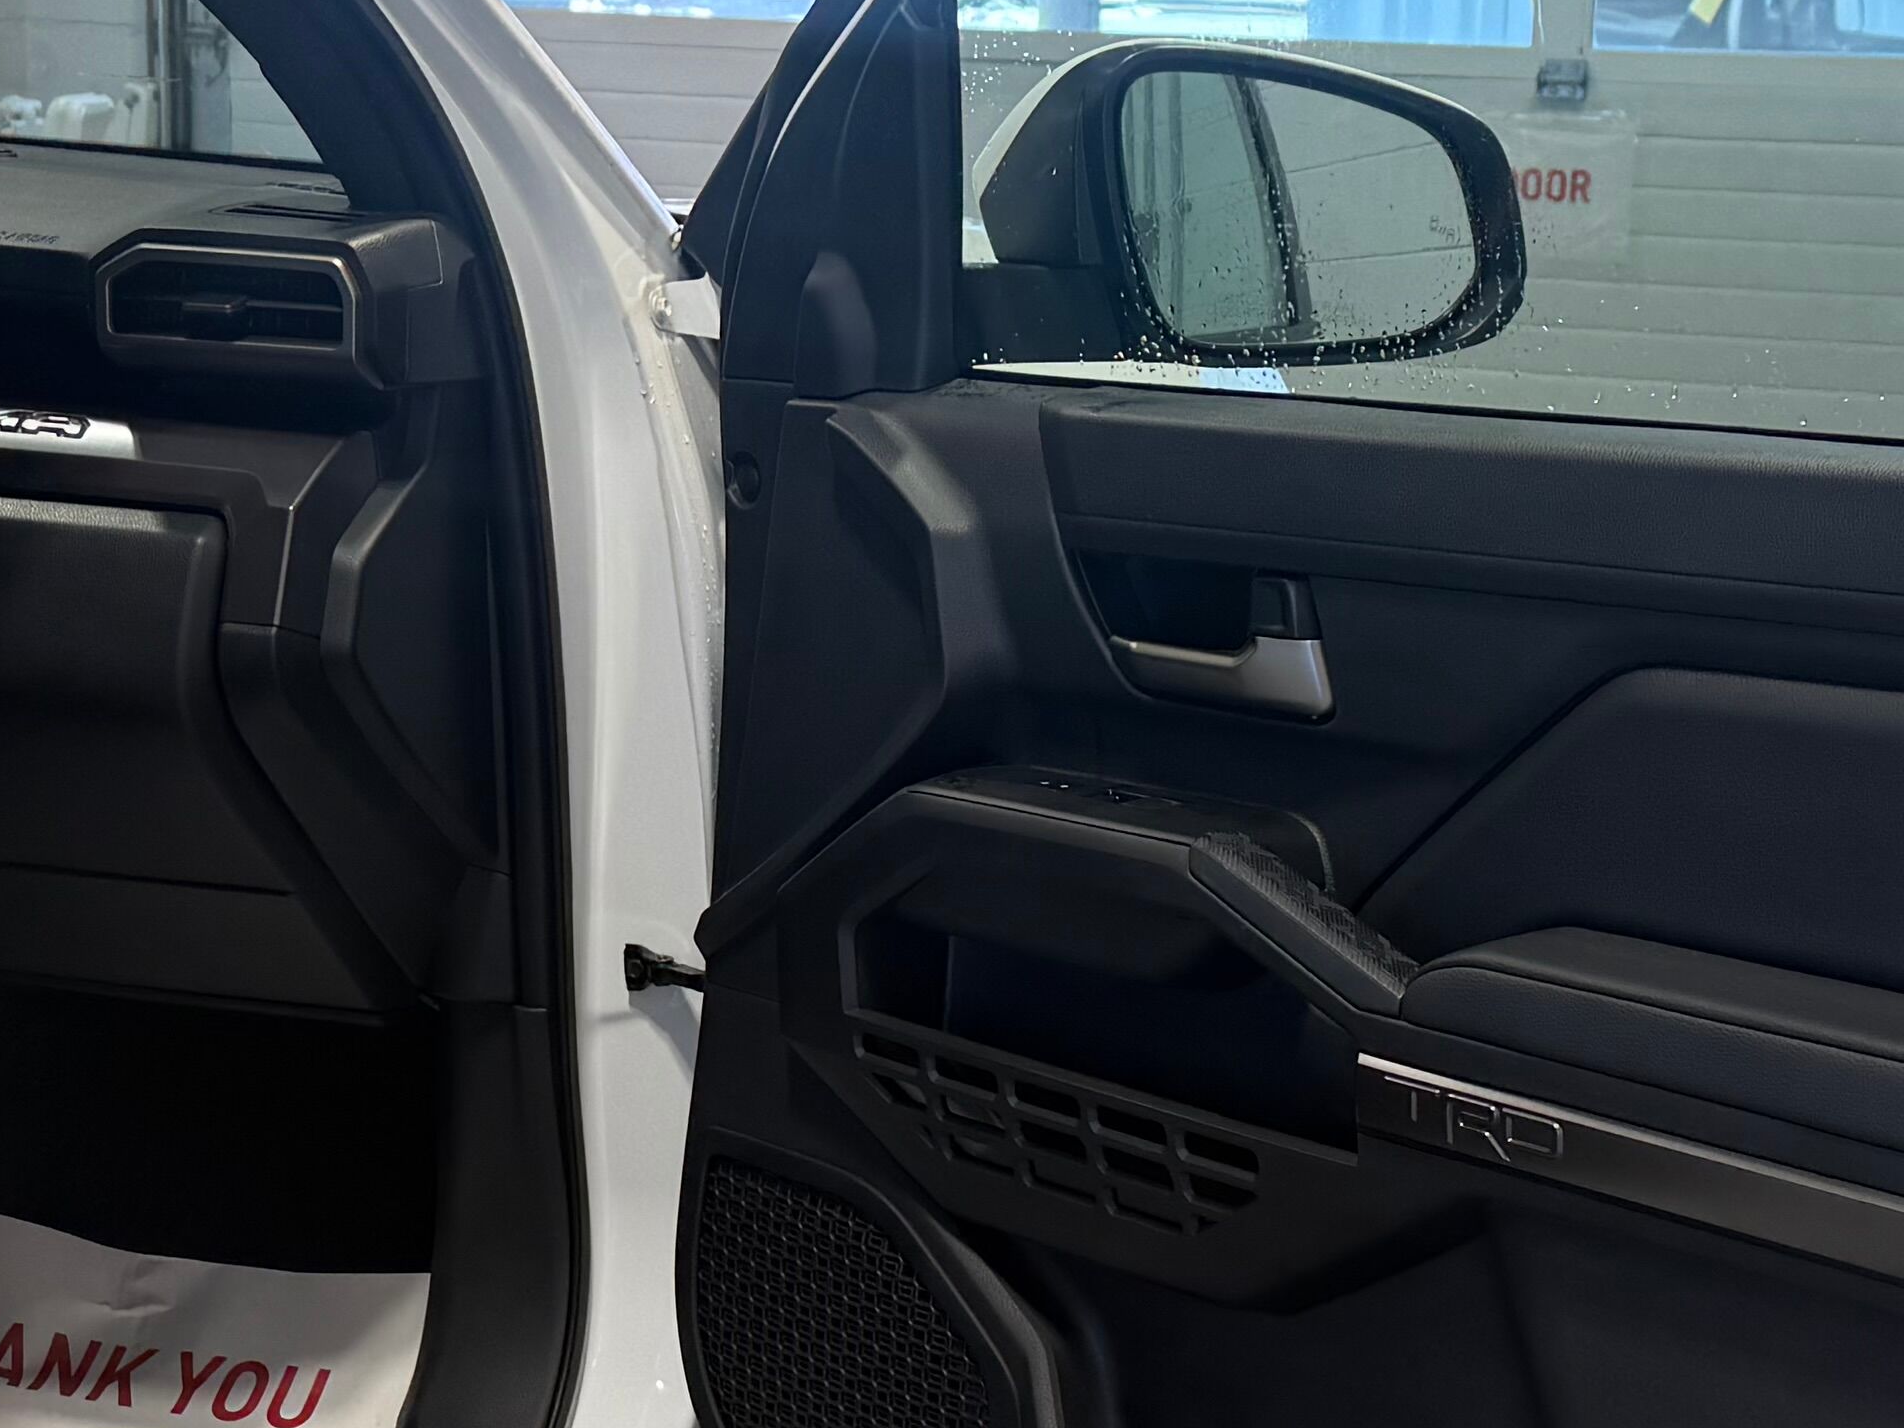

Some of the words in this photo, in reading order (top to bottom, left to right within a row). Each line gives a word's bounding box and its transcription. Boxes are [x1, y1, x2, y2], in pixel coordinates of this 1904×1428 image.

[1513, 168, 1592, 203] OOR
[1383, 1075, 1564, 1162] TRD
[169, 1350, 332, 1428] YOU
